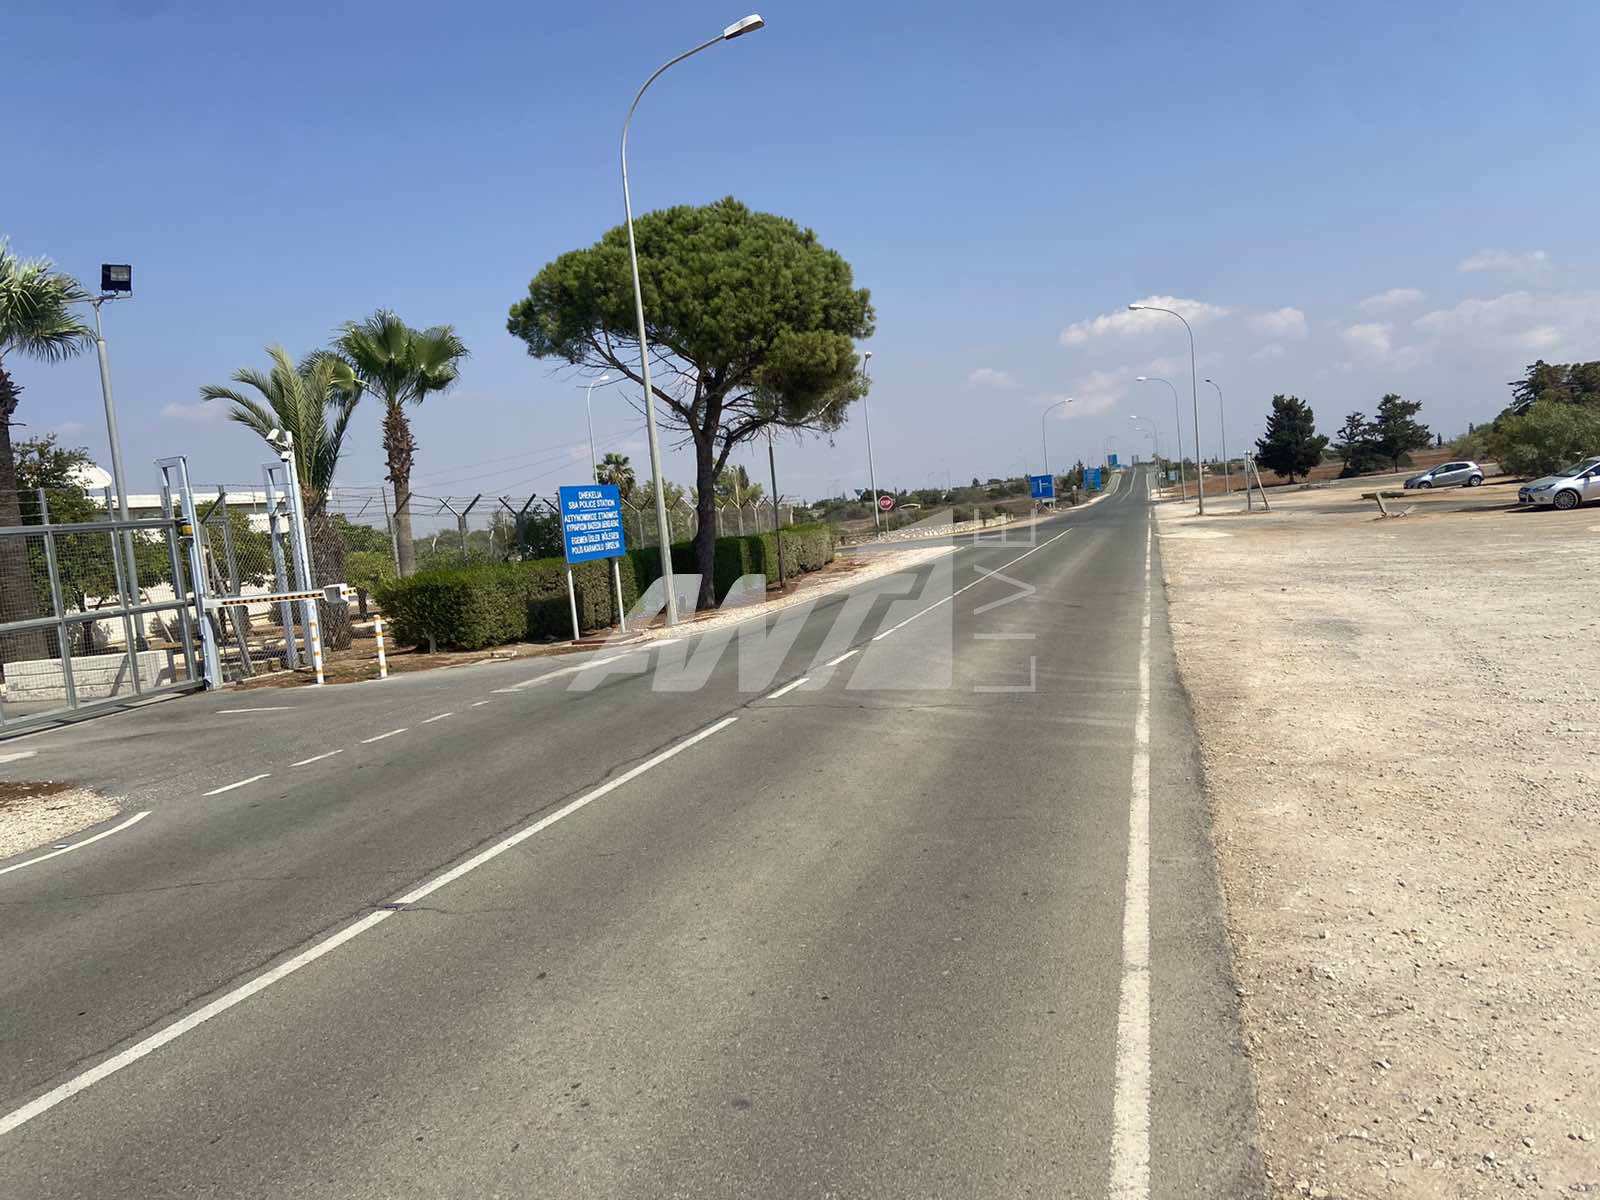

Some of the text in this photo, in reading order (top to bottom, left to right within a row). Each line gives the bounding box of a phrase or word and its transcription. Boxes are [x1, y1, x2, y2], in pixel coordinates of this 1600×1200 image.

[578, 491, 602, 499] DHEKELIA
[568, 499, 615, 509] SBA POLICE STATION
